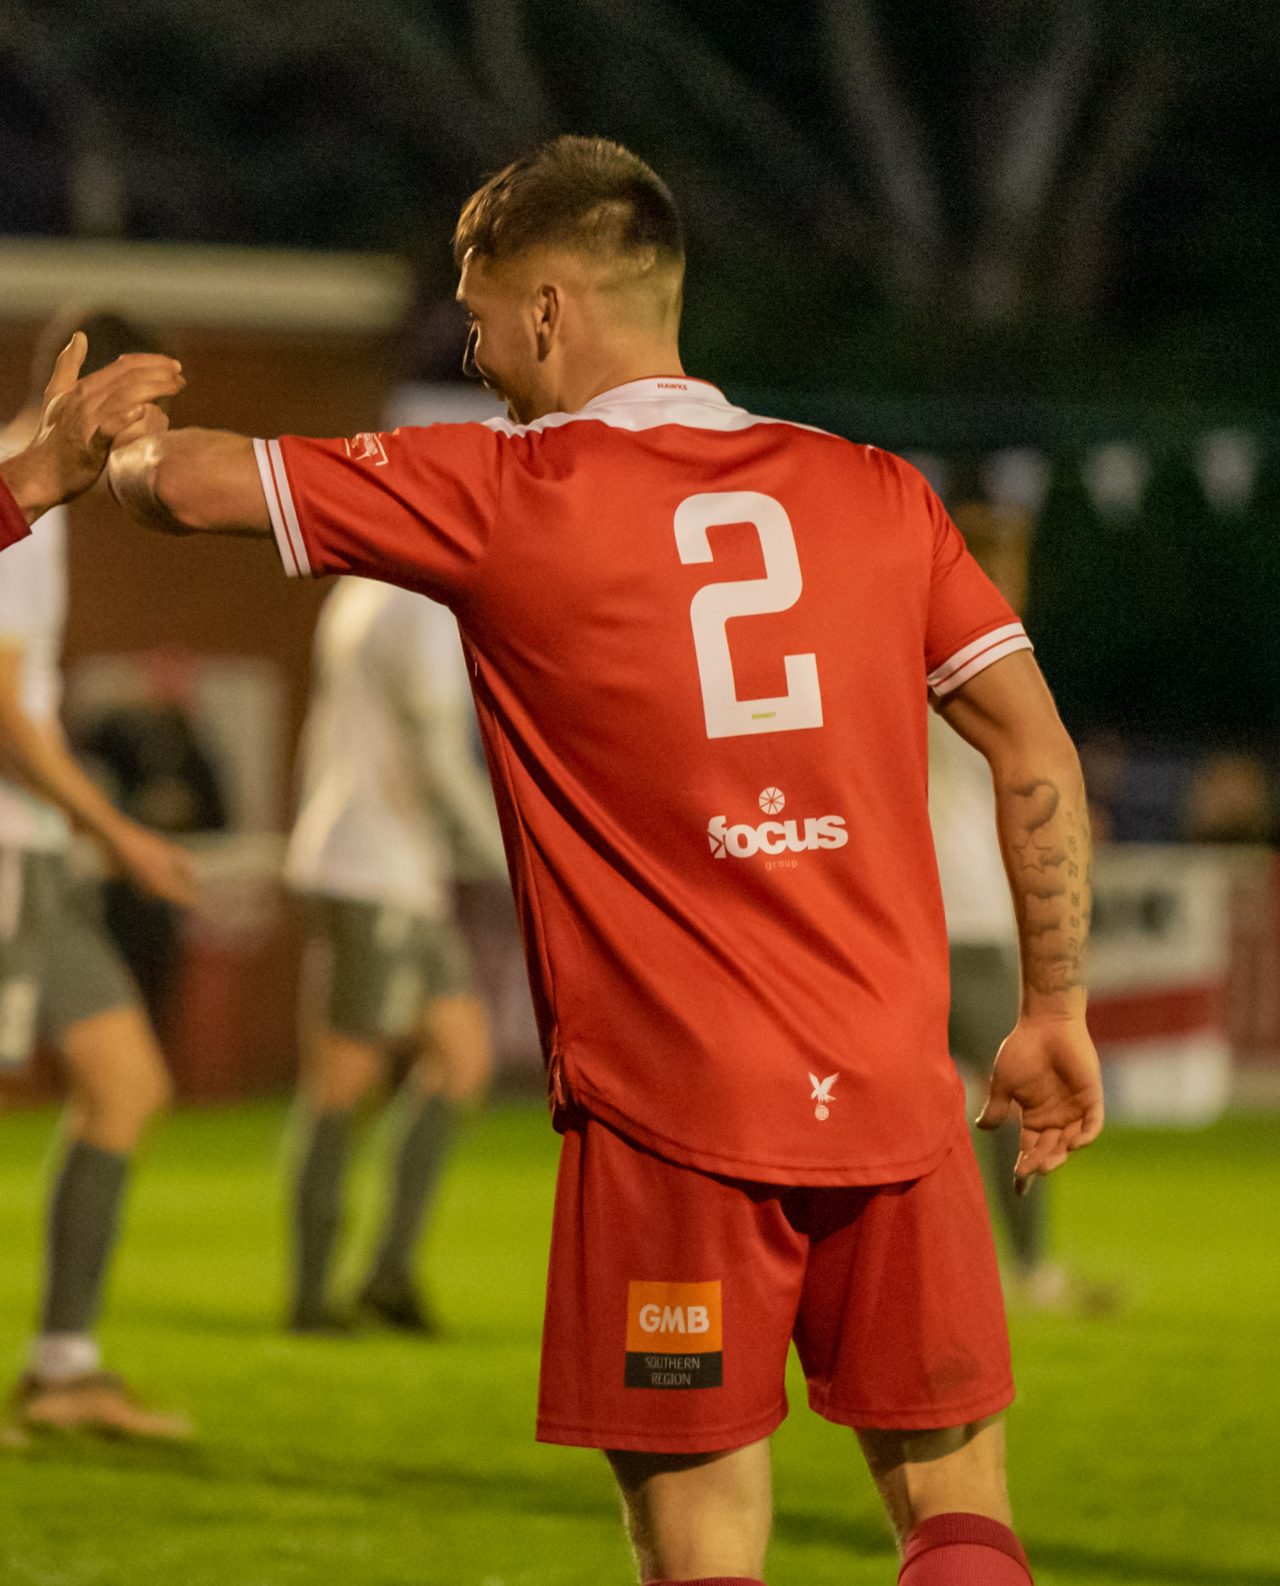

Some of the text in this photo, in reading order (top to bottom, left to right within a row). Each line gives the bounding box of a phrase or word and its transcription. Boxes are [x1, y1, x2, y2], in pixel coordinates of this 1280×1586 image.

[673, 490, 824, 740] 2
[707, 815, 849, 859] focus
[764, 859, 798, 871] group
[639, 1303, 710, 1334] GMB
[644, 1356, 701, 1370] SOUTHERN
[651, 1372, 691, 1385] REGION
